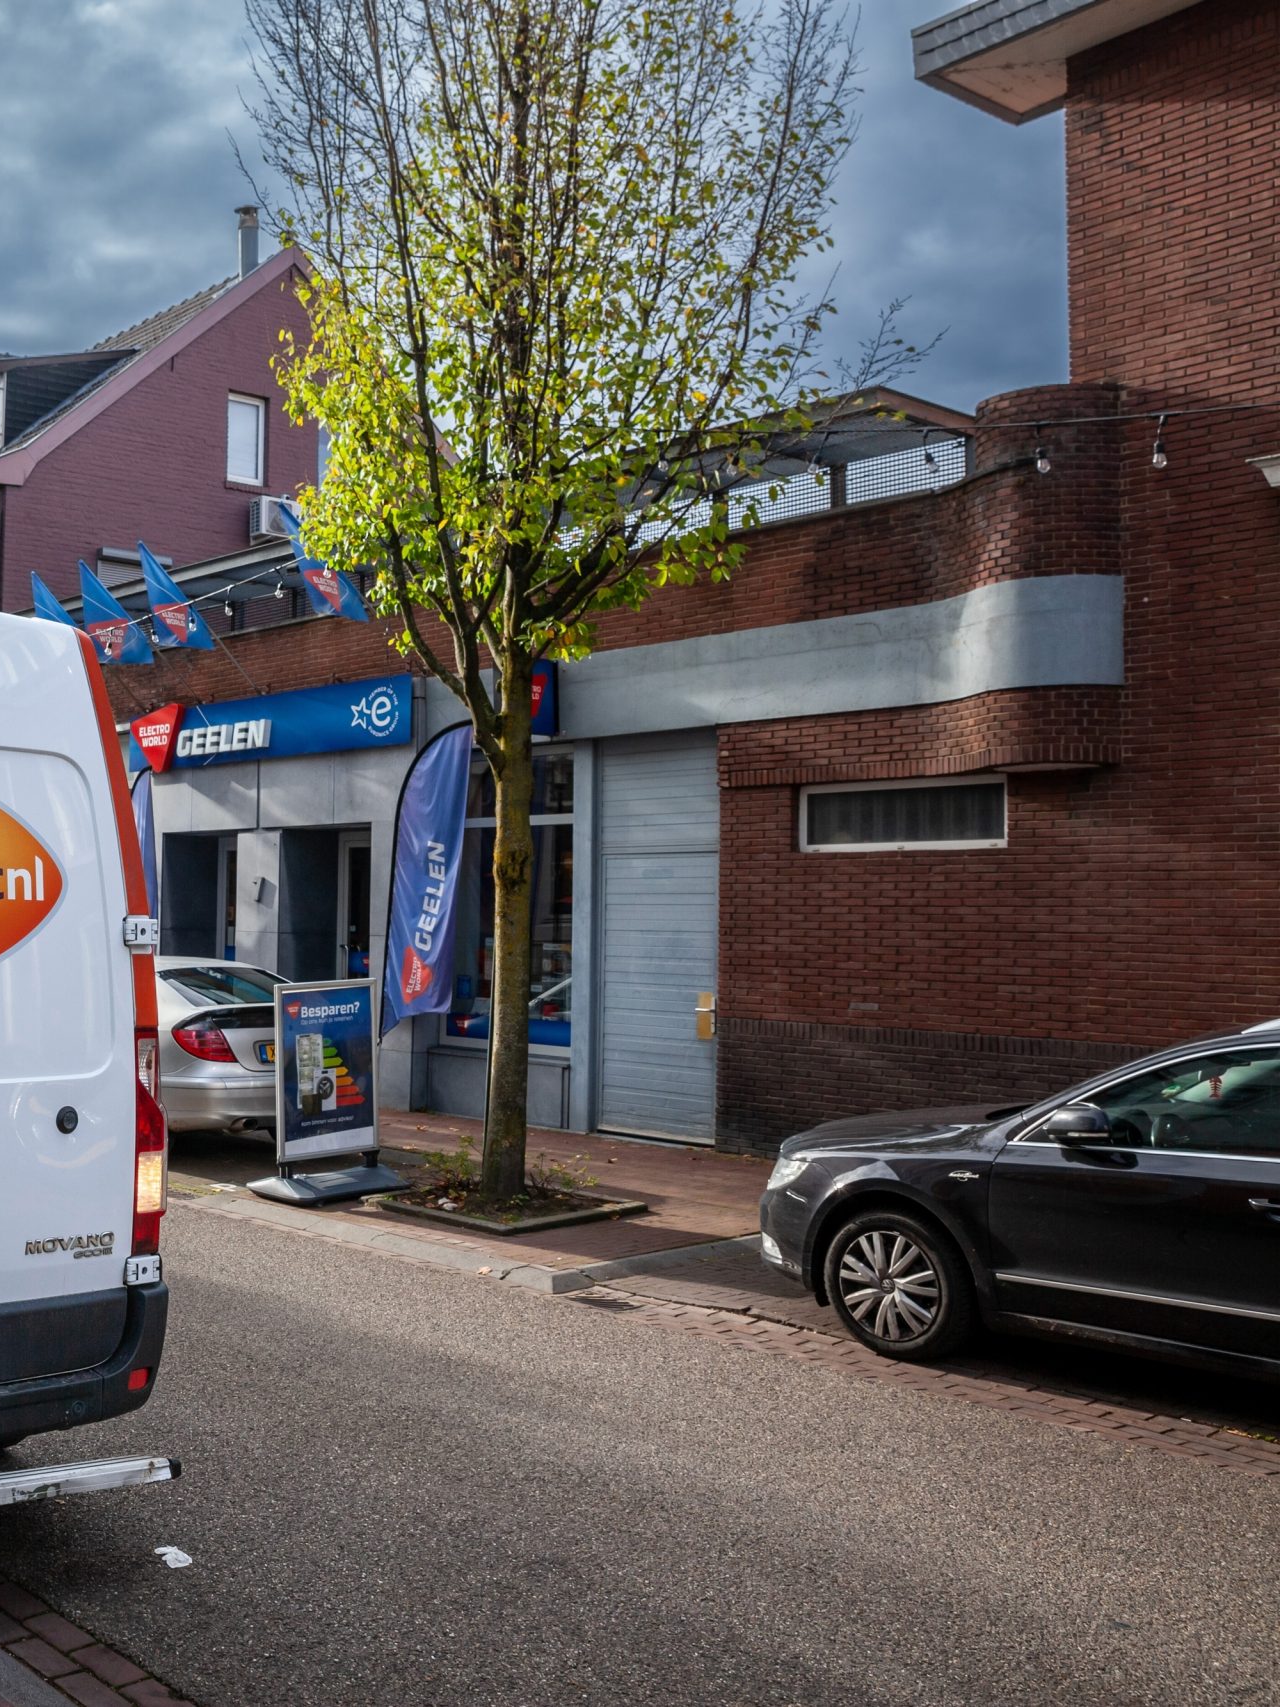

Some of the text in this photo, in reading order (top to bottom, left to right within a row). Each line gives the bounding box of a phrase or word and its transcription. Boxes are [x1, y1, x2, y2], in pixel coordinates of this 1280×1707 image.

[161, 611, 186, 621] ELECTRO
[165, 618, 186, 627] WORLD
[138, 723, 171, 737] ELECTRO
[141, 735, 168, 748] WORLD
[176, 718, 270, 758] GEELEN
[414, 840, 446, 952] GEELEN
[301, 1001, 360, 1018] Besparen?
[25, 1231, 115, 1256] MOVANO
